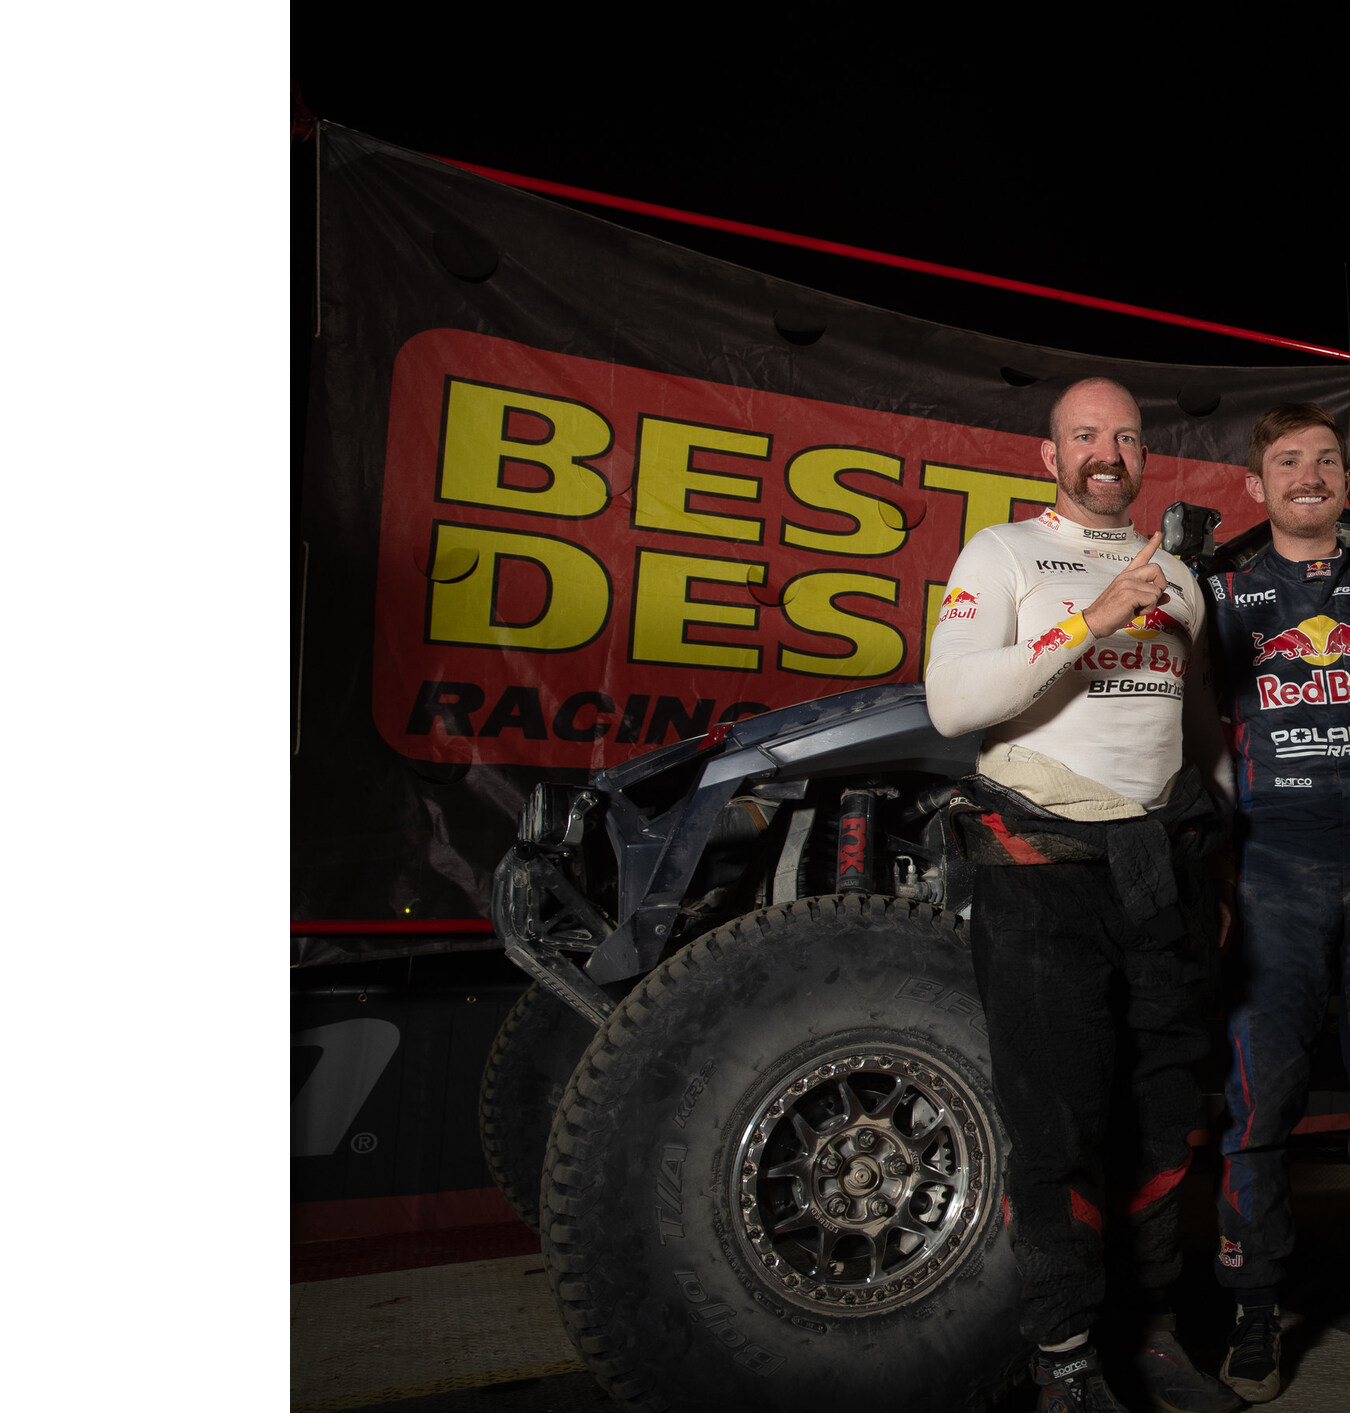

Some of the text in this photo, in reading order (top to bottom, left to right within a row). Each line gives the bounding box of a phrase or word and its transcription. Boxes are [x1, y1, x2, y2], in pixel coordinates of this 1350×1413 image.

[439, 374, 1058, 559] BEST
[1083, 529, 1127, 540] sparco
[423, 519, 945, 684] DES
[949, 607, 977, 620] Bull
[1033, 661, 1072, 699] sparco
[1256, 669, 1327, 710] Red
[1274, 776, 1313, 788] sparco
[839, 817, 867, 876] FOX
[810, 1207, 839, 1235] FORGED
[1053, 1359, 1088, 1379] sparco
